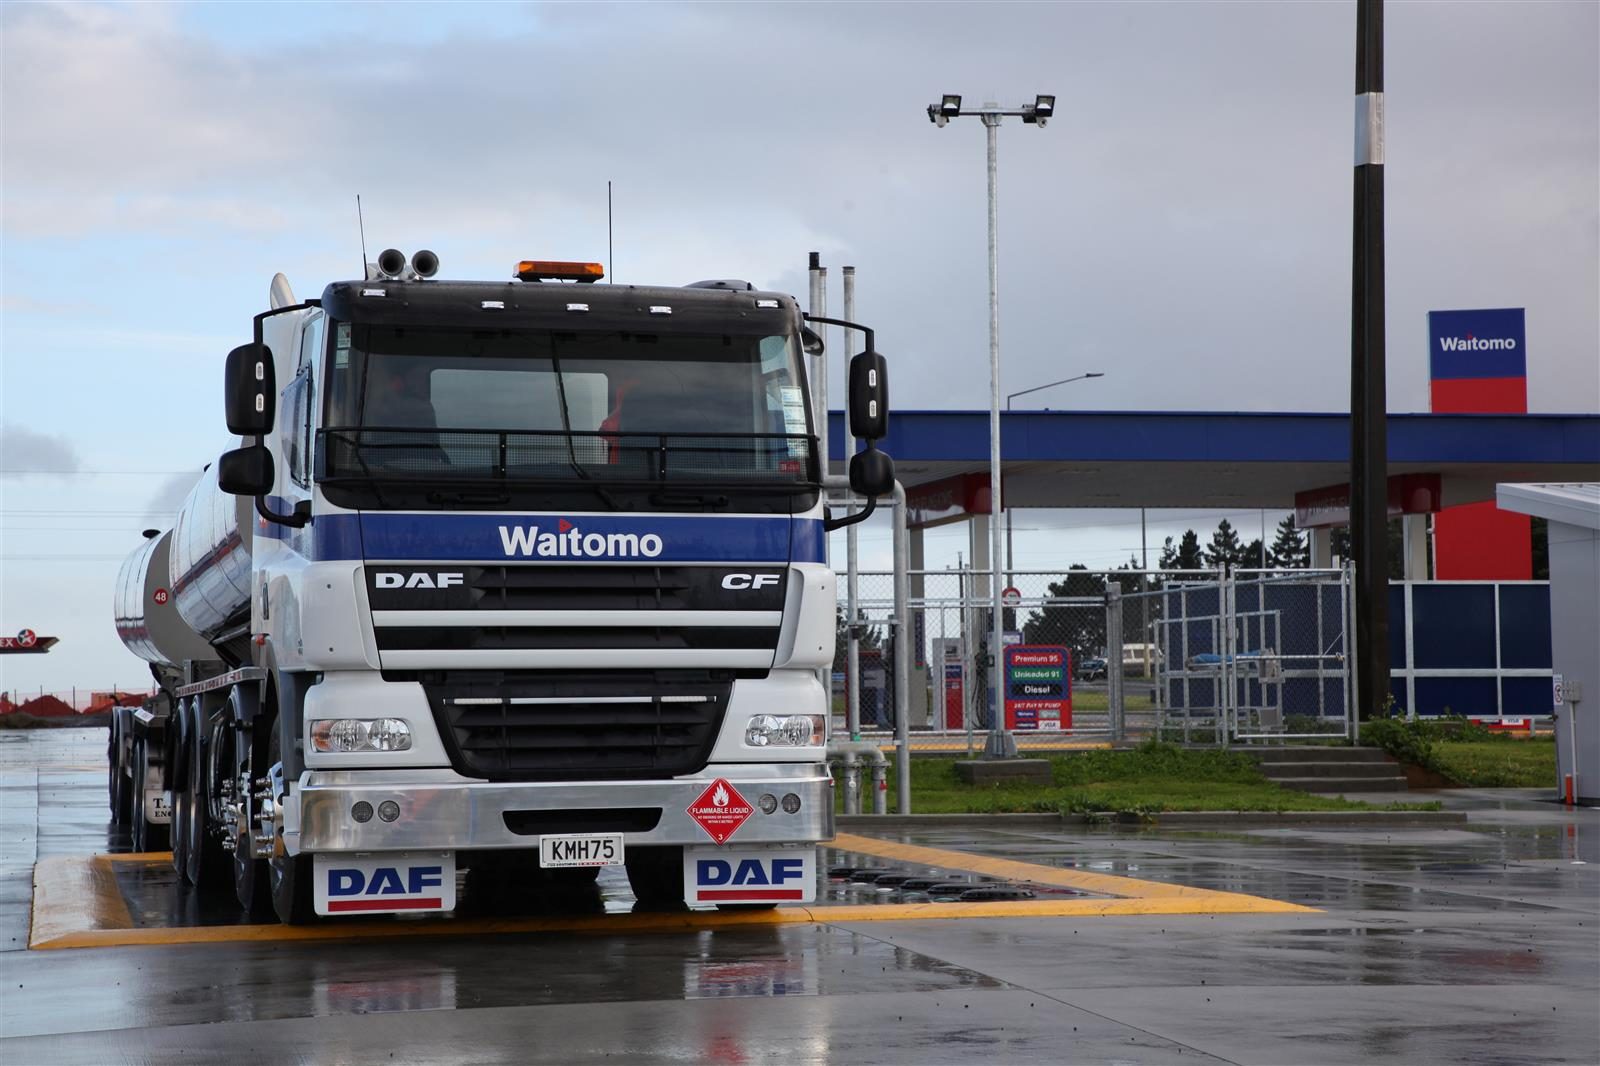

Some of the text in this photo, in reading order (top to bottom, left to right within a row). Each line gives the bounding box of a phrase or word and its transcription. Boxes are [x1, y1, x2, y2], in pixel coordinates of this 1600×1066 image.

[1440, 335, 1516, 351] Waitomo
[498, 519, 663, 557] Waitomo
[375, 573, 464, 588] DAF
[721, 573, 781, 589] CF
[155, 591, 167, 602] 48
[1024, 685, 1050, 693] Diesel
[552, 840, 614, 860] KMH75
[697, 859, 803, 885] DAF
[328, 867, 442, 896] DAF
